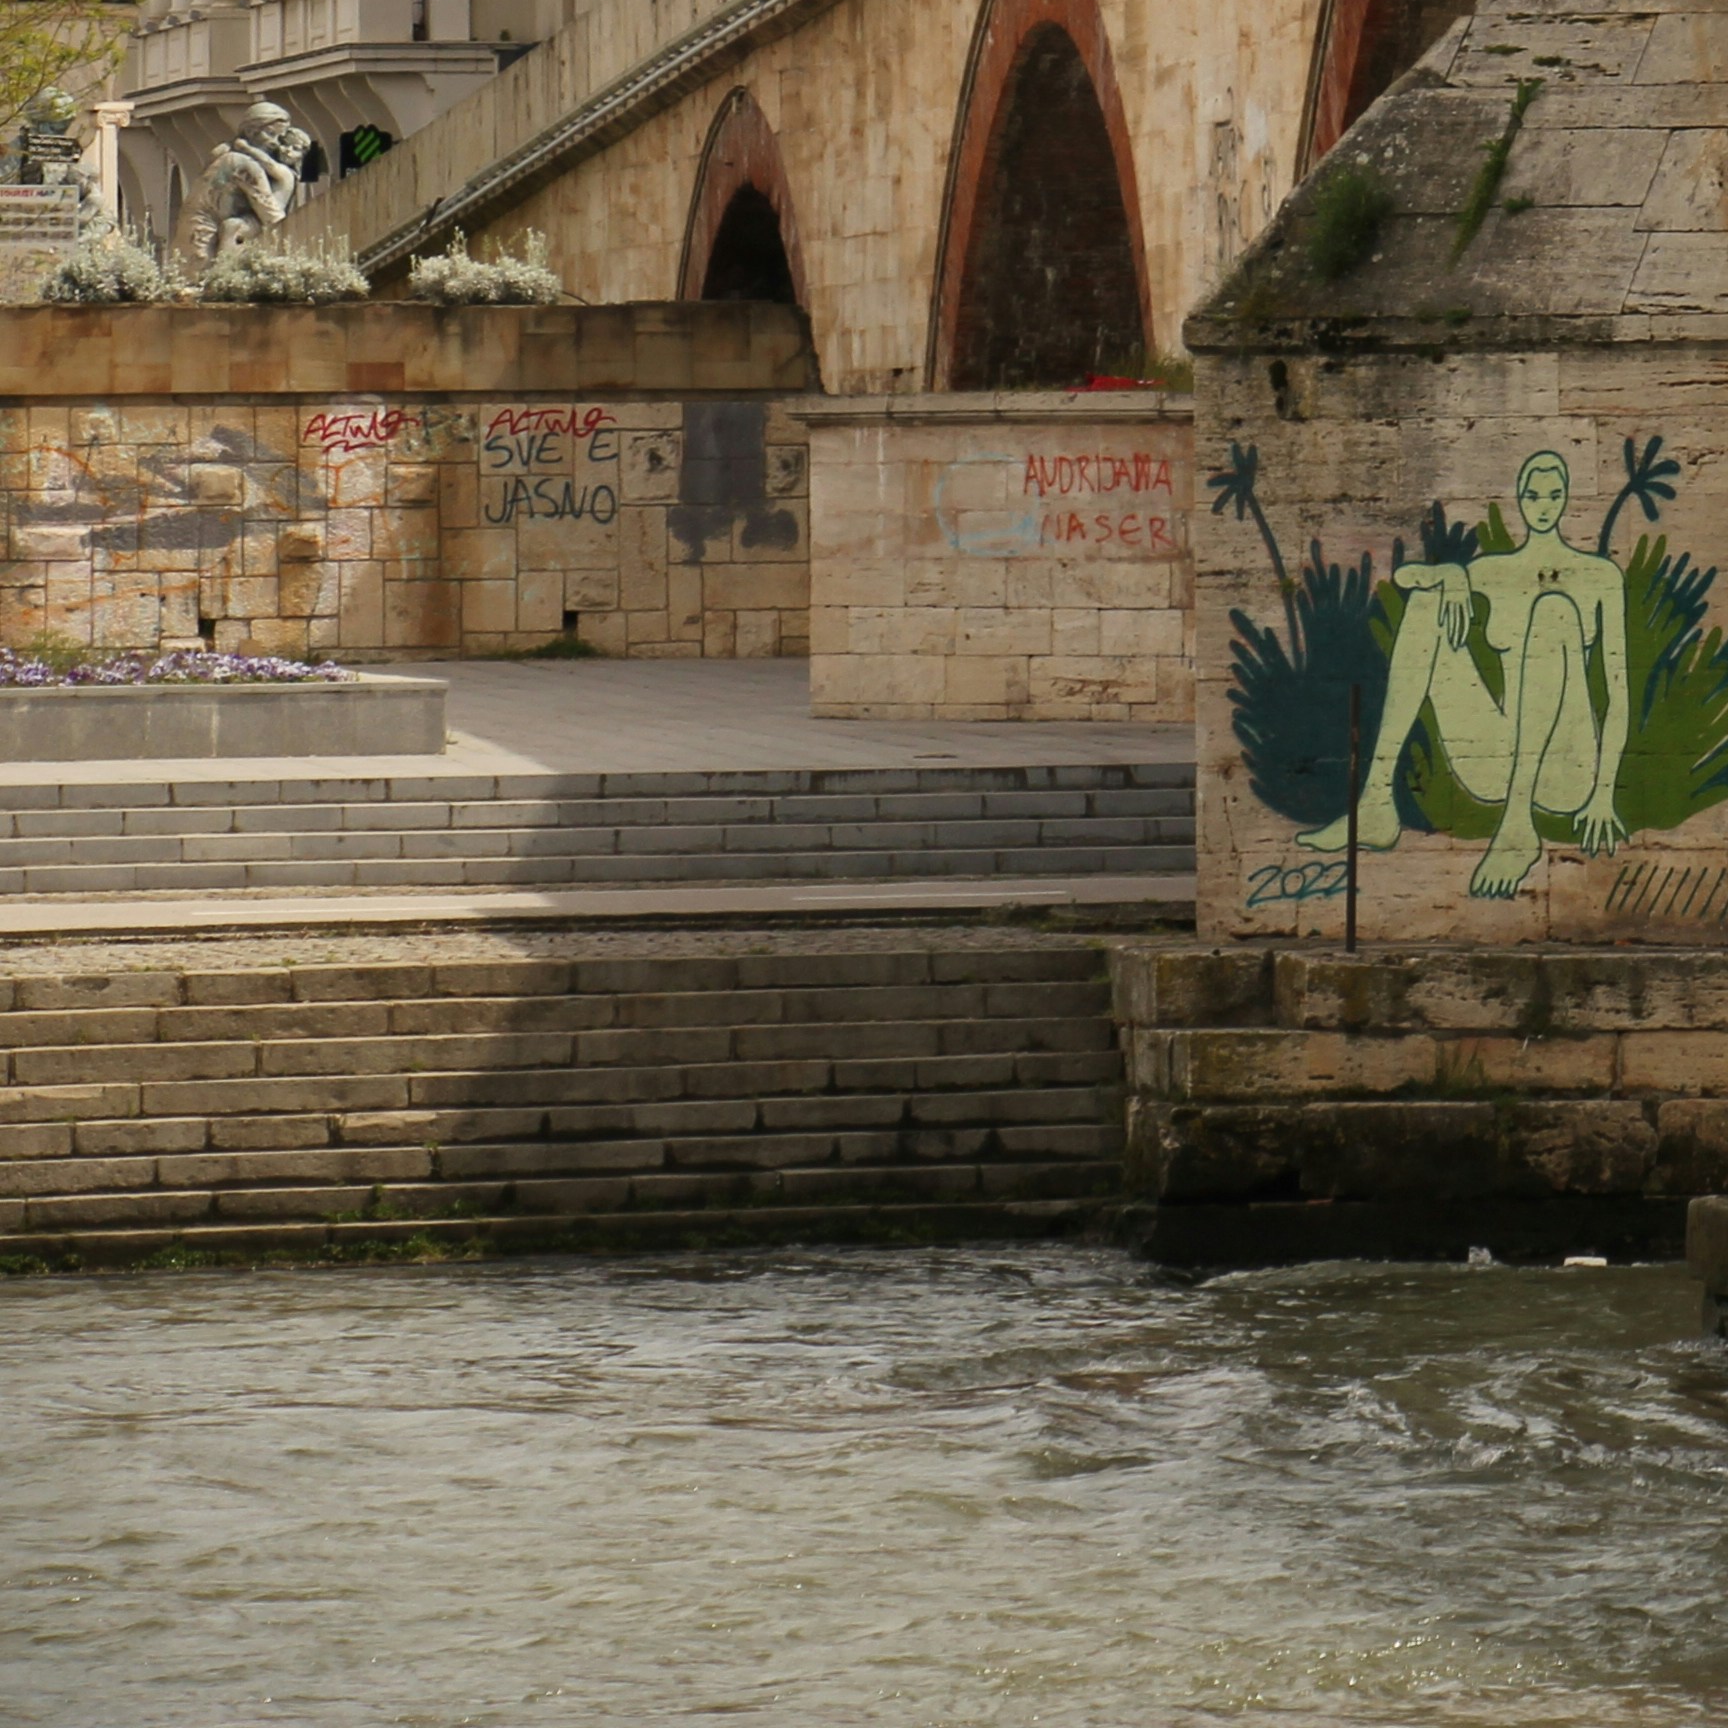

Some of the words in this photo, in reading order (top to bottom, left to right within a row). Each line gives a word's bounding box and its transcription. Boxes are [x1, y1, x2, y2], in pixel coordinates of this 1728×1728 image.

[484, 432, 563, 469] SVE
[588, 429, 619, 463] E
[484, 477, 617, 524] JASNO
[1246, 860, 1361, 909] 2022
